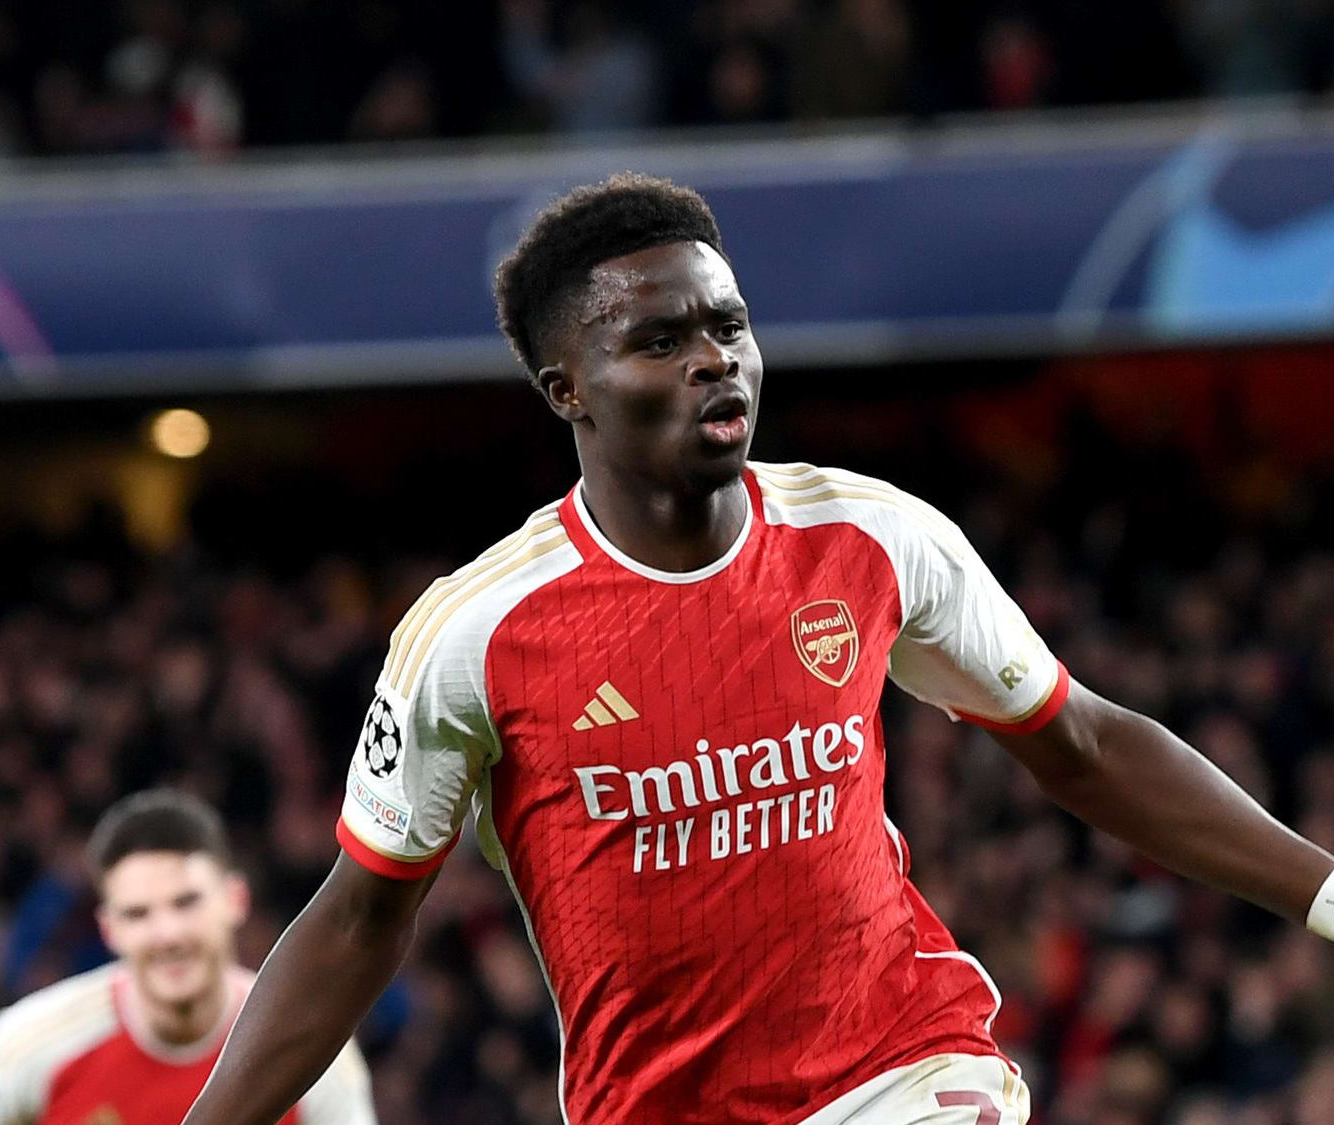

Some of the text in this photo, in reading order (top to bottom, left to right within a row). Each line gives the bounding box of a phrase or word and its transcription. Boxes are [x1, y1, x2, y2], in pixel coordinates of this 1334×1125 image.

[800, 612, 844, 636] Arsenal
[573, 714, 865, 822] Emirates
[632, 783, 836, 874] FLY BETTER
